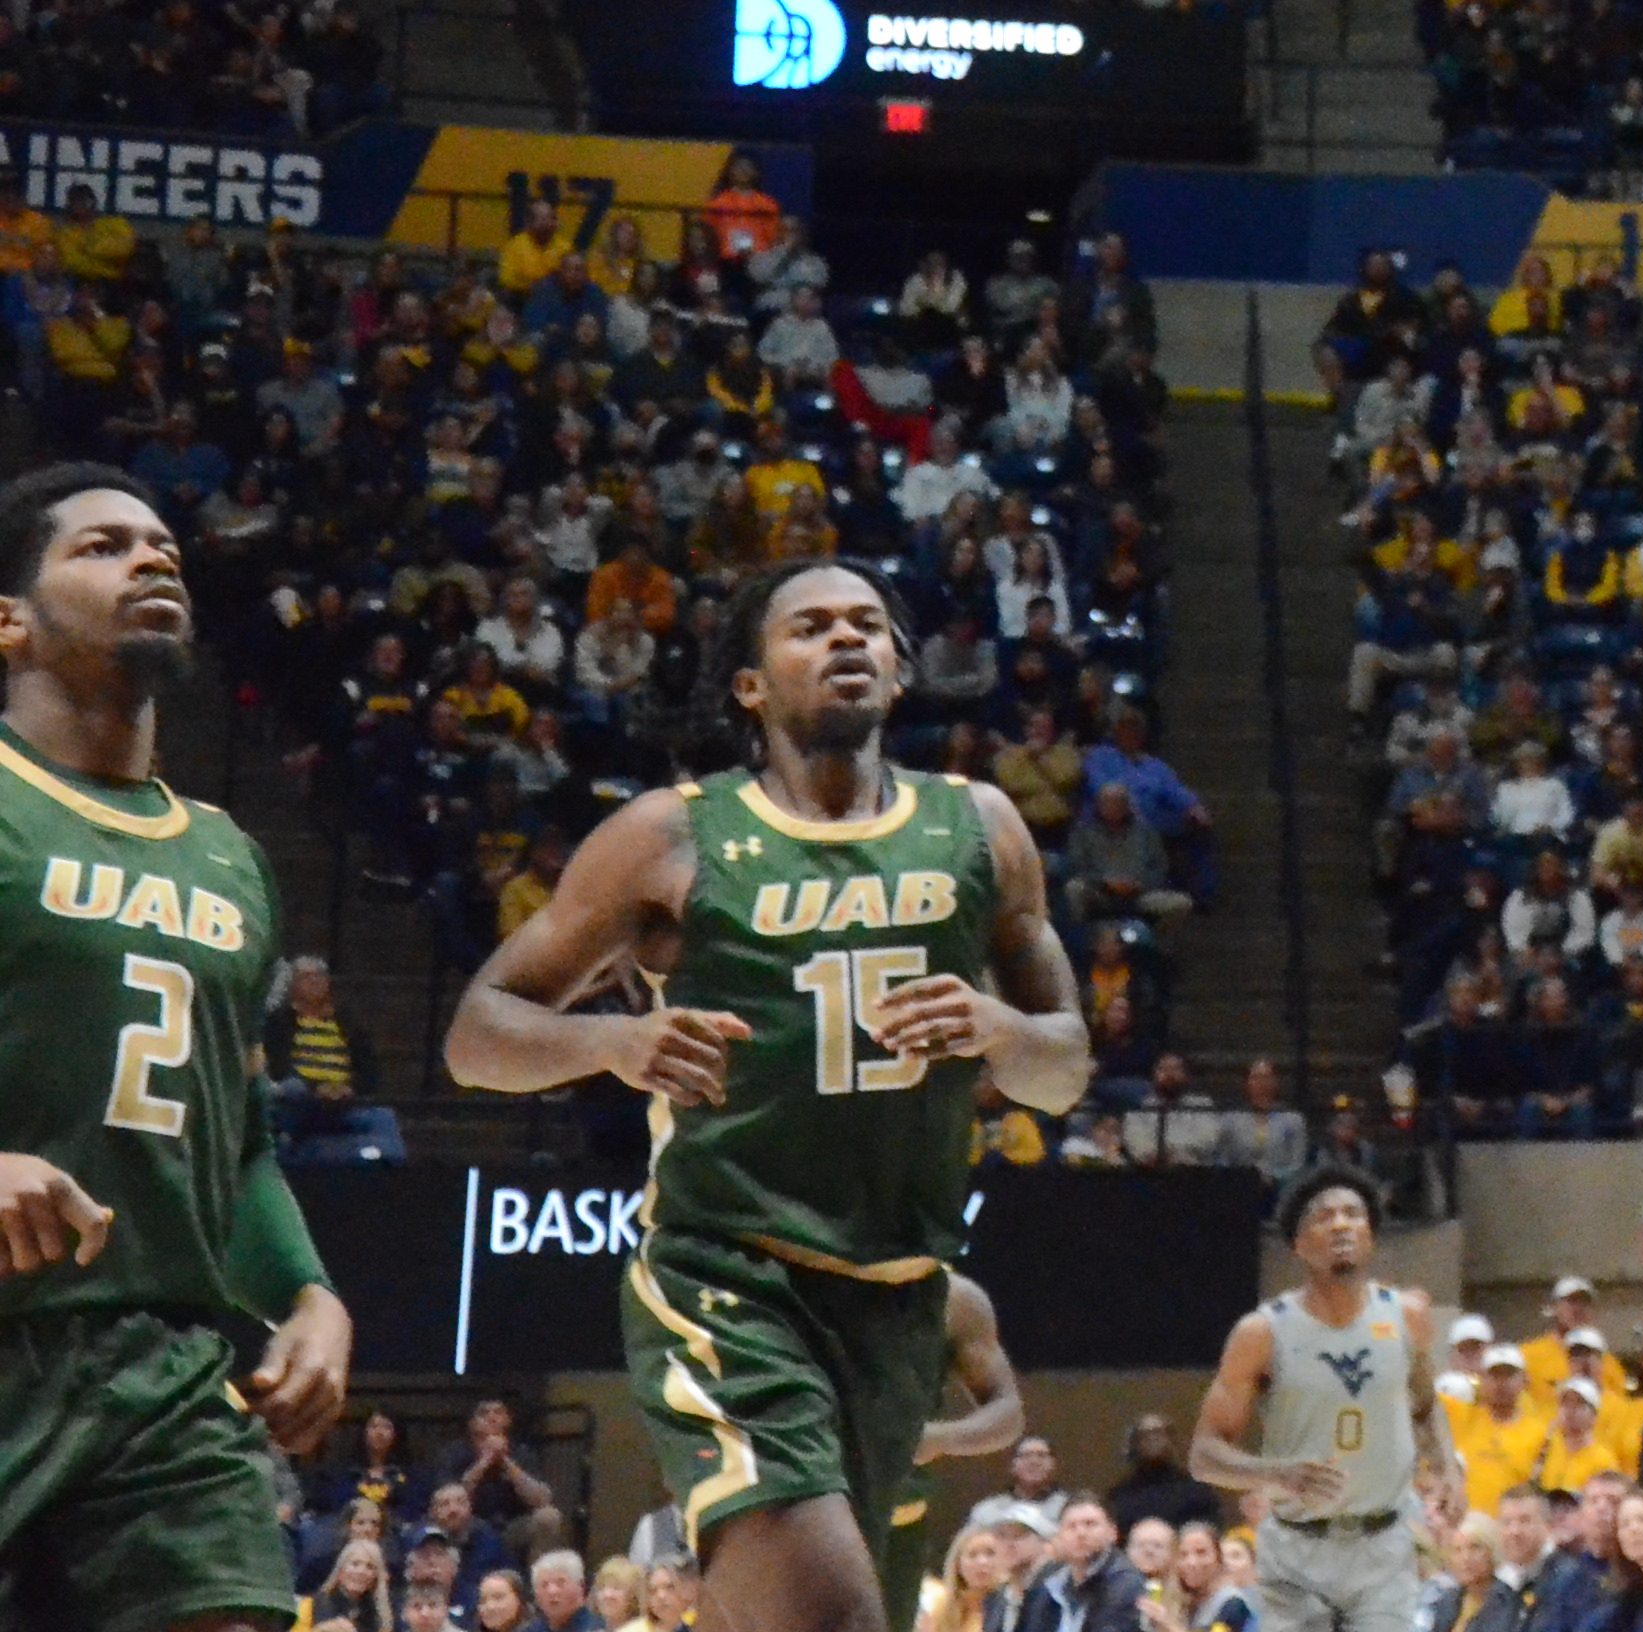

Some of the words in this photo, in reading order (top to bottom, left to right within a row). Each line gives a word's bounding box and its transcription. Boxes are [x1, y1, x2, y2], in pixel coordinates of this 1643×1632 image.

[865, 46, 974, 80] energy
[867, 14, 1084, 55] DIVERSIFIED
[40, 857, 245, 953] UAB
[751, 871, 958, 937] UAB
[103, 953, 195, 1138] 2
[793, 946, 928, 1095] 15
